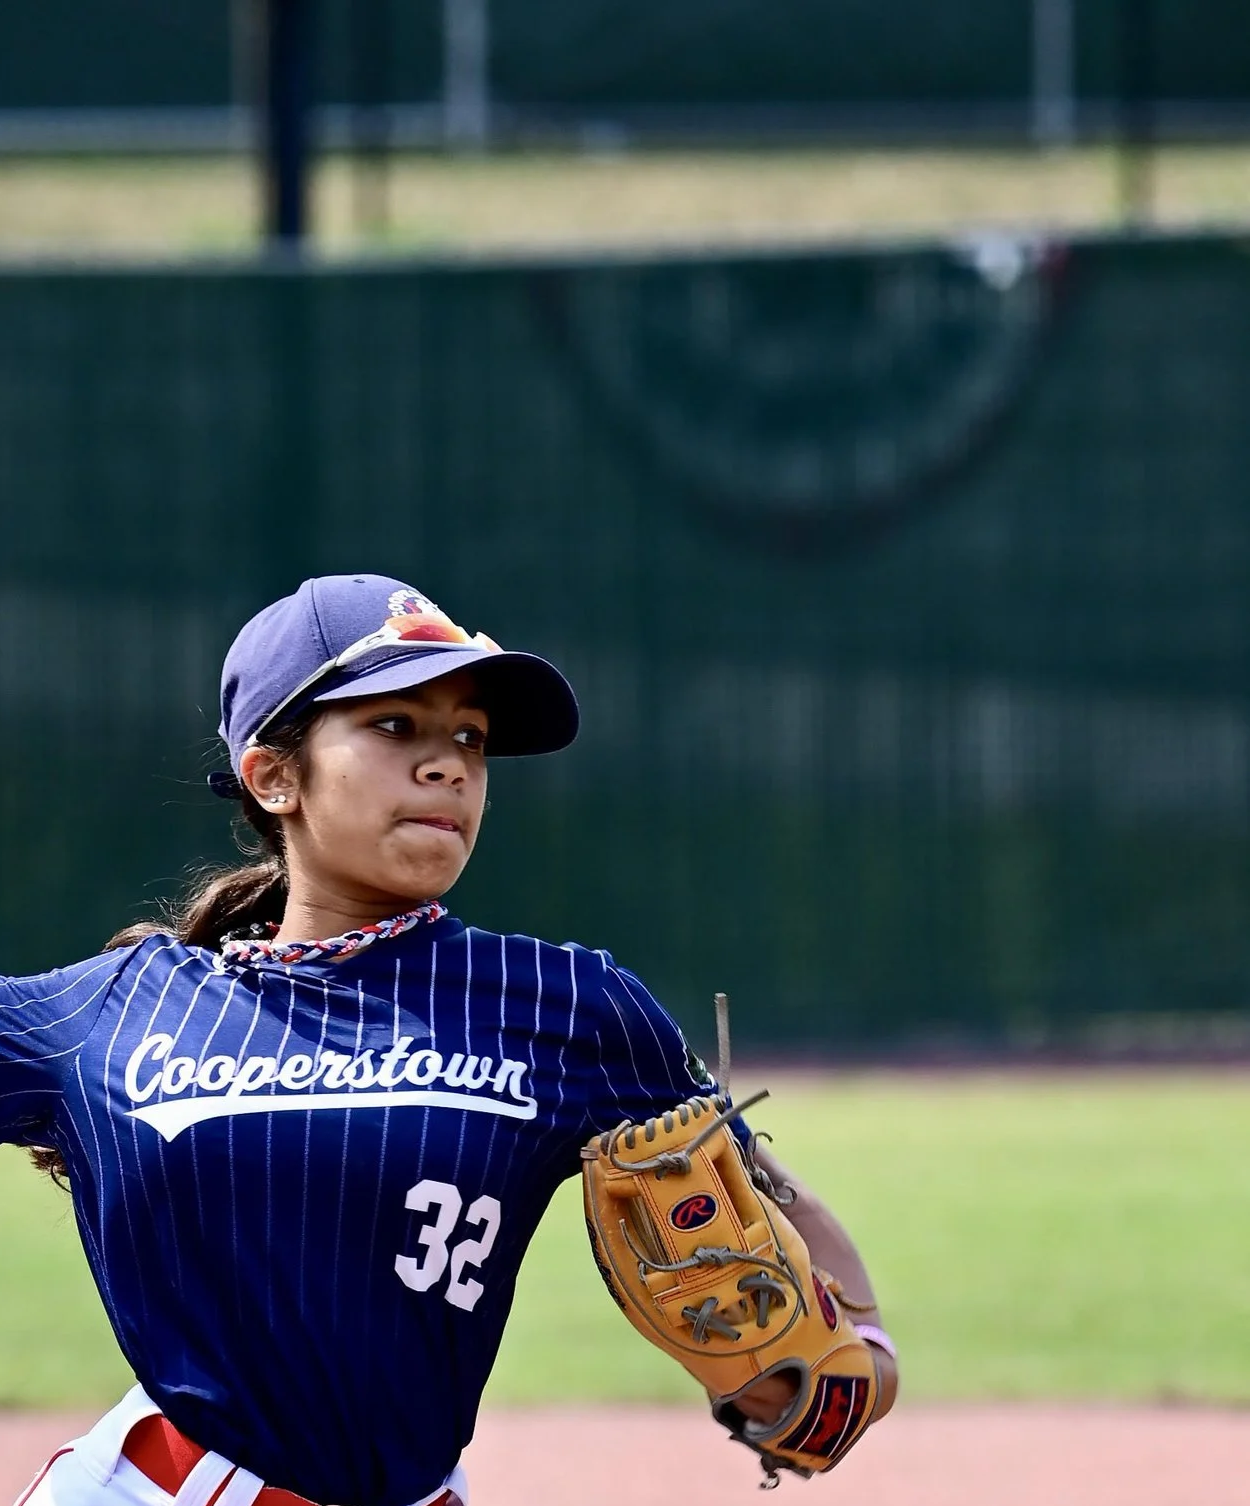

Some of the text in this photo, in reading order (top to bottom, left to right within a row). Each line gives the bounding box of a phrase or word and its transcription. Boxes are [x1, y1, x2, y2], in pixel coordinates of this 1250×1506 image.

[124, 1032, 536, 1112] Cooperstown
[394, 1179, 502, 1313] 32
[674, 1197, 713, 1228] R
